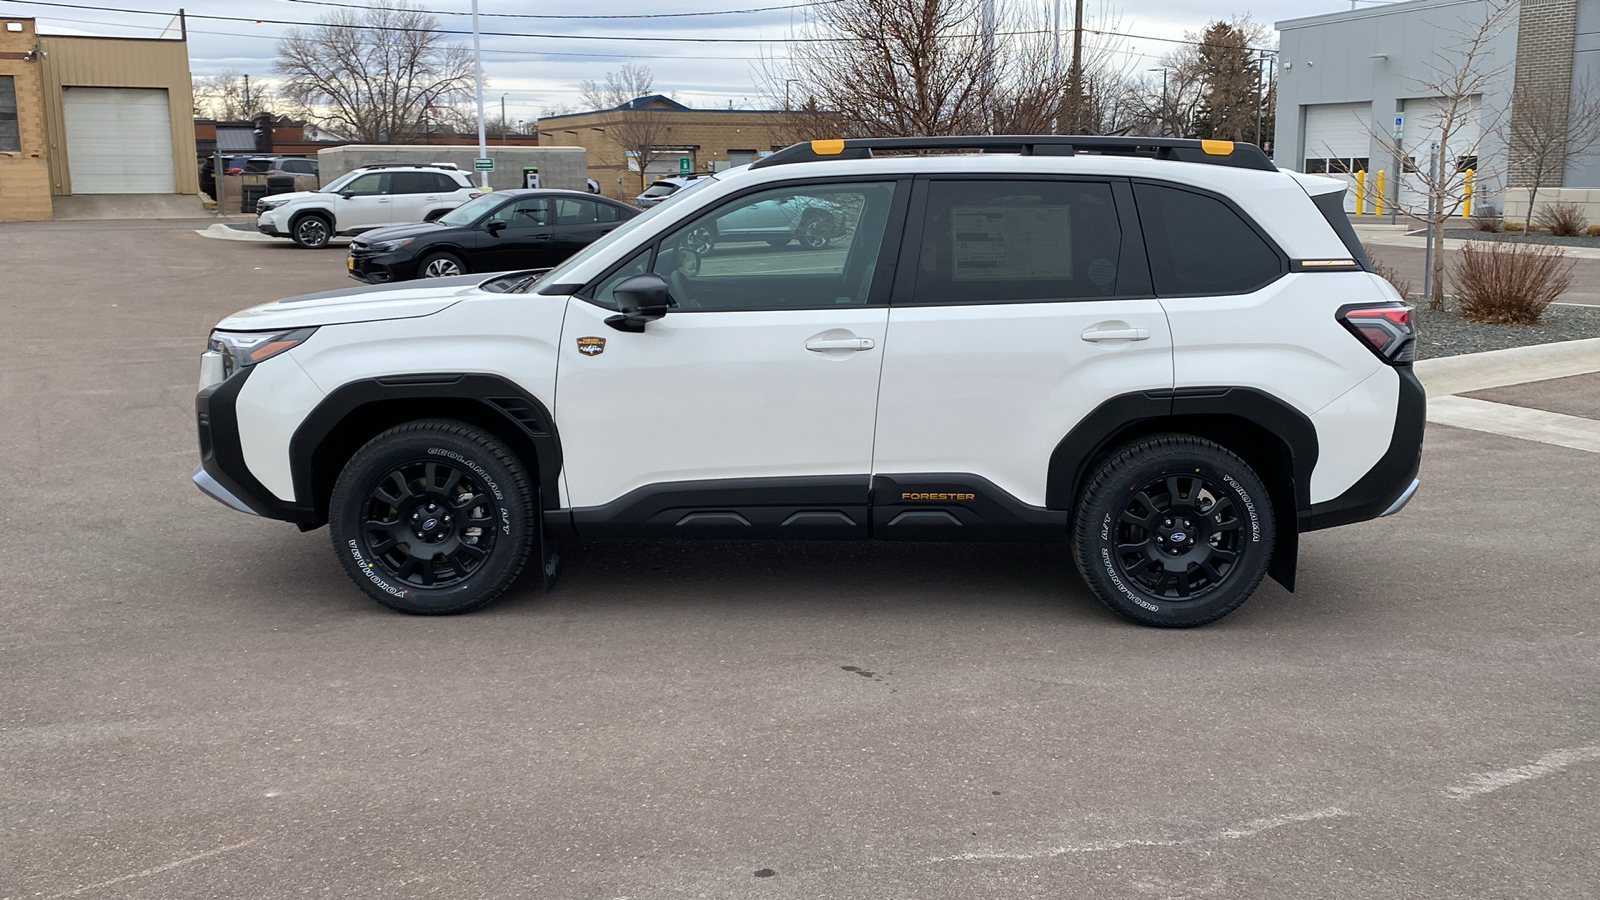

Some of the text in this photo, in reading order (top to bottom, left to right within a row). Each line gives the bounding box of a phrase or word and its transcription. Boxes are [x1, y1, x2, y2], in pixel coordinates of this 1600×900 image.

[427, 447, 510, 535] GEOLANDAR A/T
[901, 492, 975, 500] FORESTER
[1222, 474, 1260, 542] YOKOHAMA
[348, 539, 405, 598] YOKOHAMA
[1101, 513, 1159, 612] GEOLANDAR A/T
